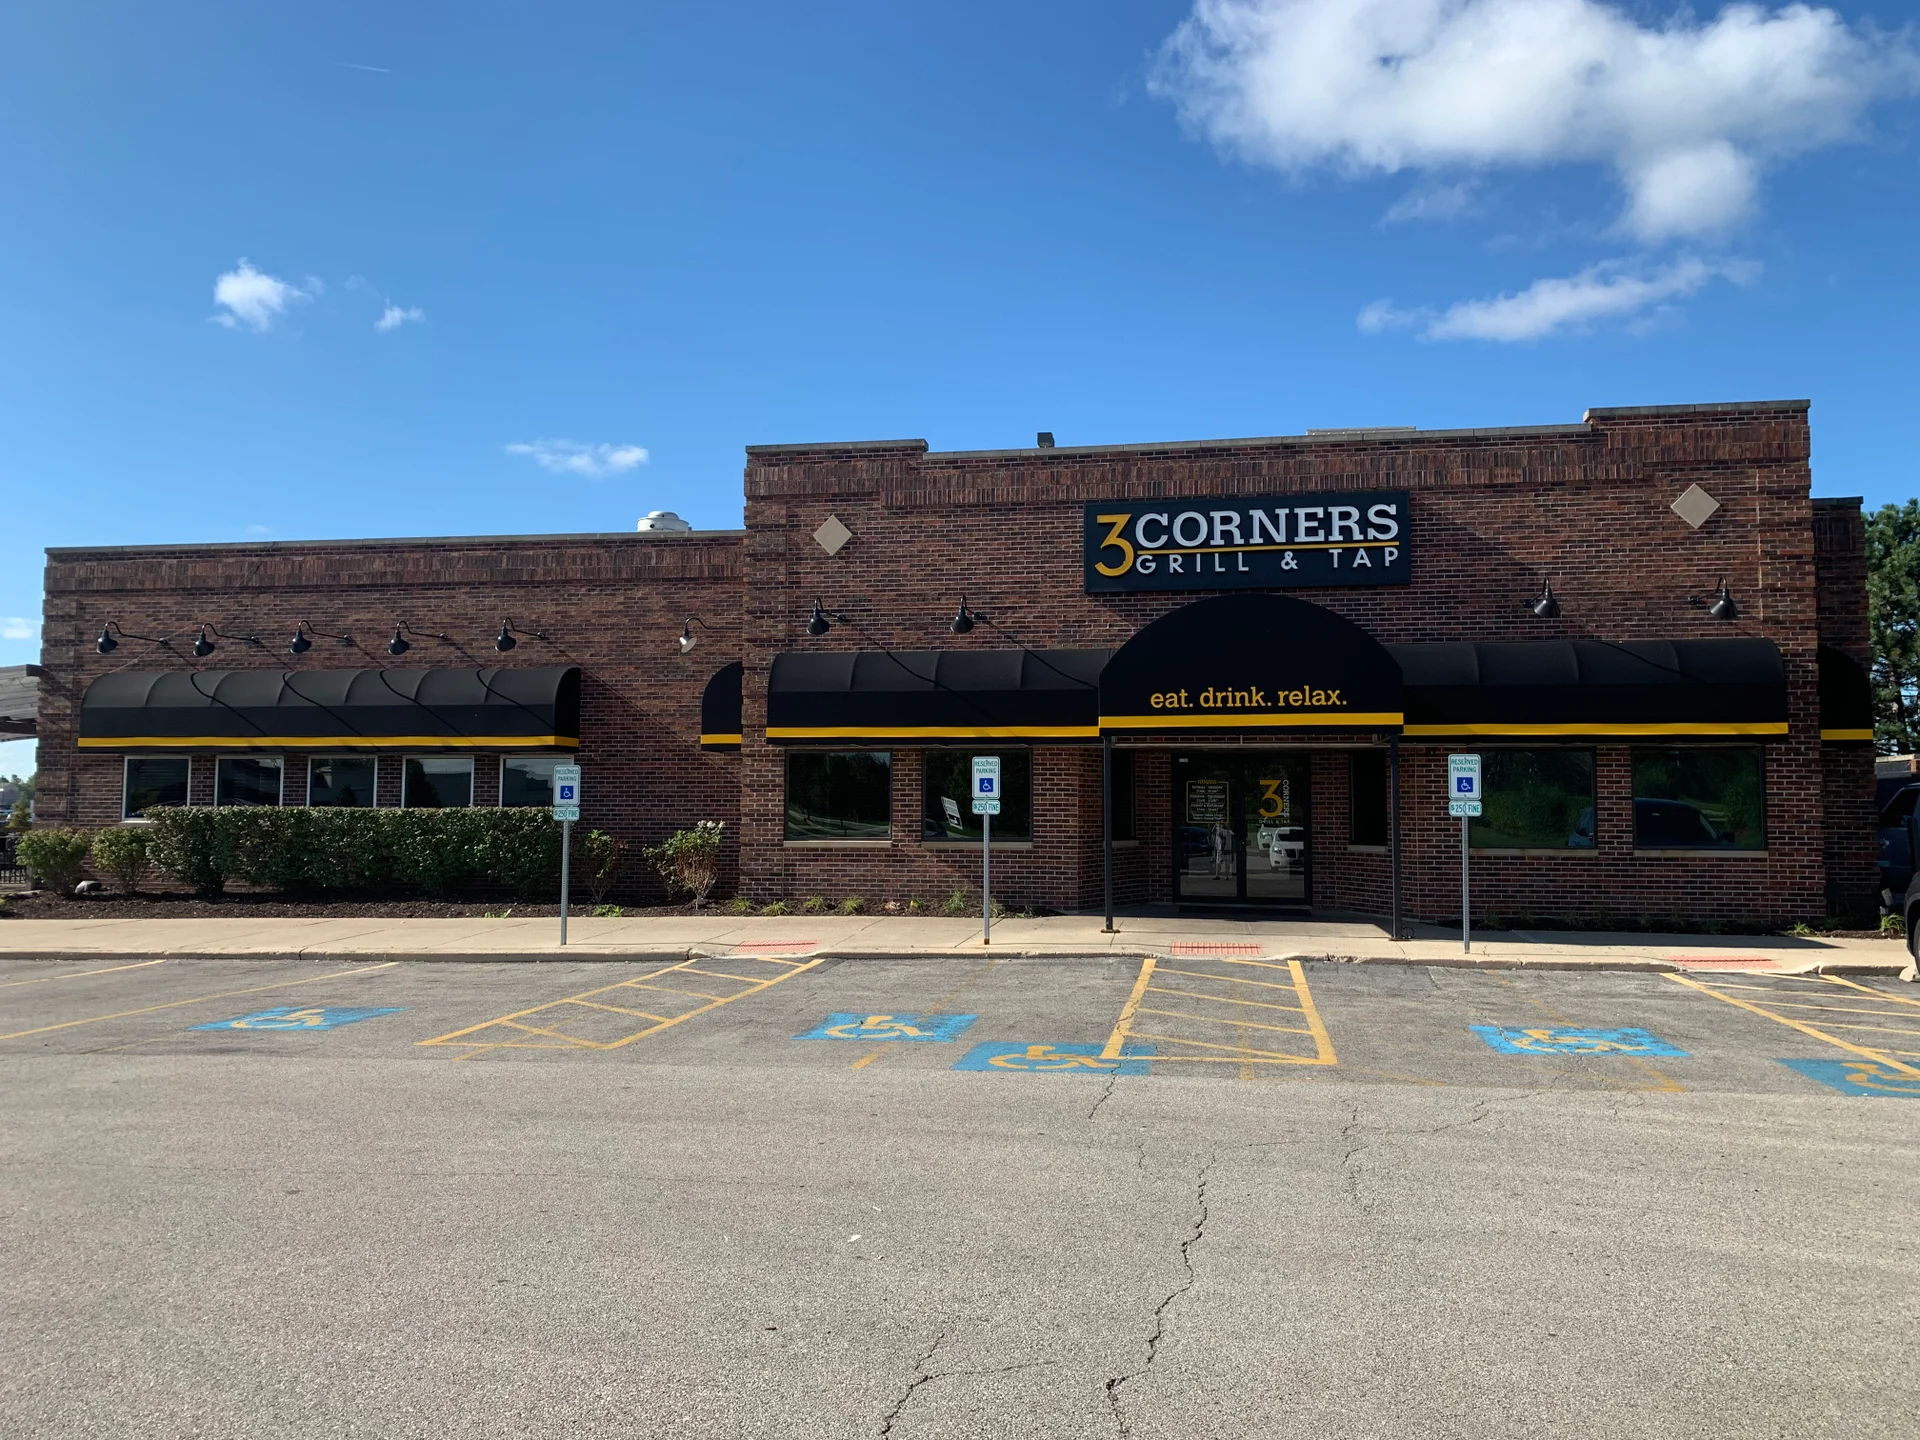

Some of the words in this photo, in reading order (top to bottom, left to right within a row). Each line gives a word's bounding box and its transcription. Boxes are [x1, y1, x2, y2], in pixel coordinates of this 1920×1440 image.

[1094, 514, 1135, 577] 3
[1135, 503, 1399, 549] CORNERS
[1136, 552, 1249, 574] GRILL
[1281, 551, 1299, 571] &
[1328, 547, 1399, 569] TAP
[1150, 689, 1194, 709] eat.
[1199, 686, 1272, 708] drink.
[1278, 685, 1347, 707] relax.
[988, 803, 999, 812] FINE
[1258, 779, 1283, 818] 3
[1282, 779, 1290, 818] CORNERS
[1468, 804, 1480, 813] FINE
[568, 809, 579, 818] FINE
